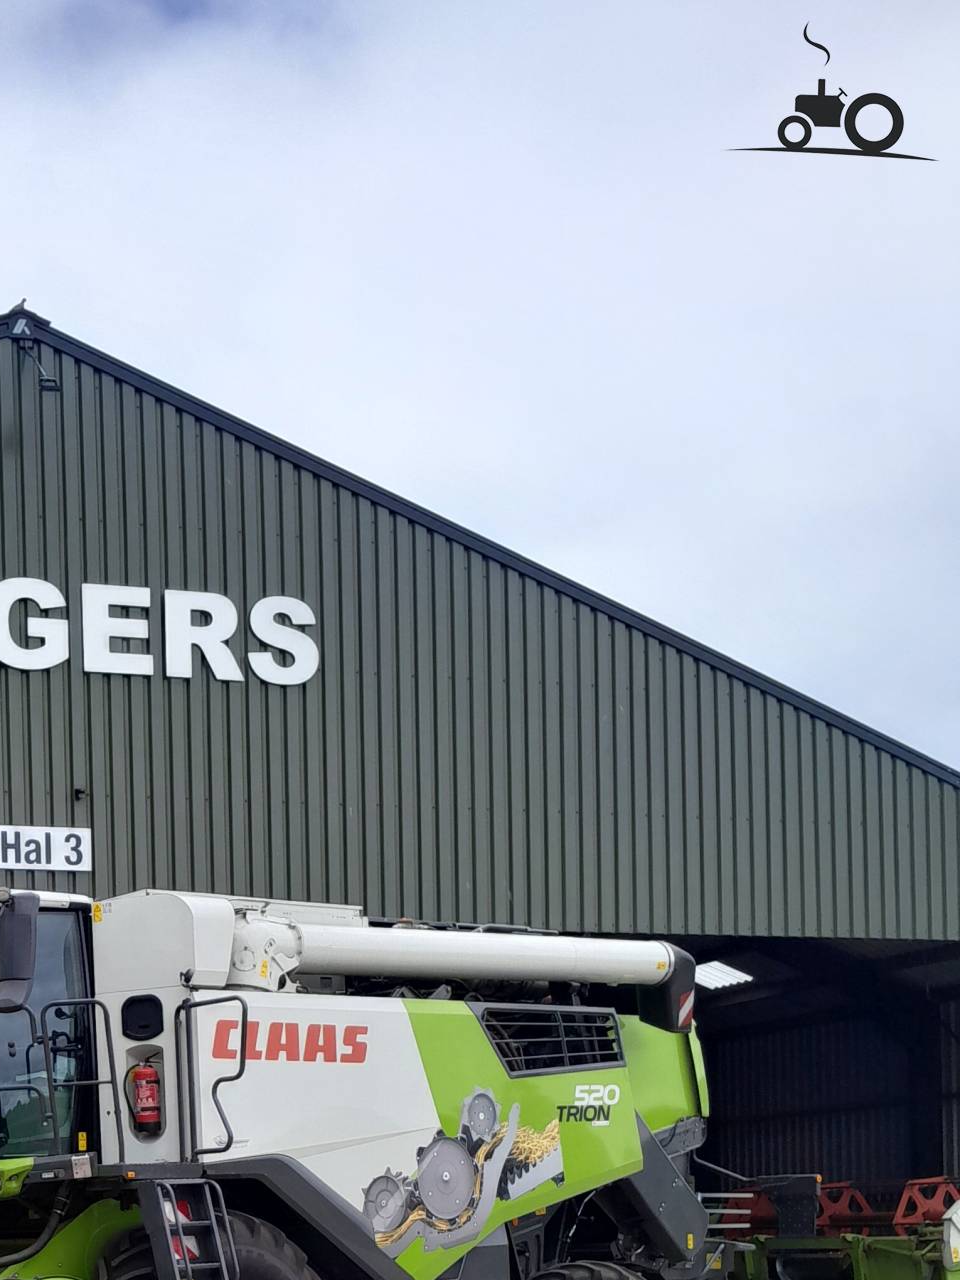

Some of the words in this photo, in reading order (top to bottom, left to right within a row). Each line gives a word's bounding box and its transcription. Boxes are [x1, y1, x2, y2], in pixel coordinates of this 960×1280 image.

[0, 830, 52, 865] Hal
[63, 832, 84, 866] 3
[211, 1019, 369, 1064] CLAAS
[573, 1083, 621, 1106] 520
[556, 1104, 611, 1123] TRION
